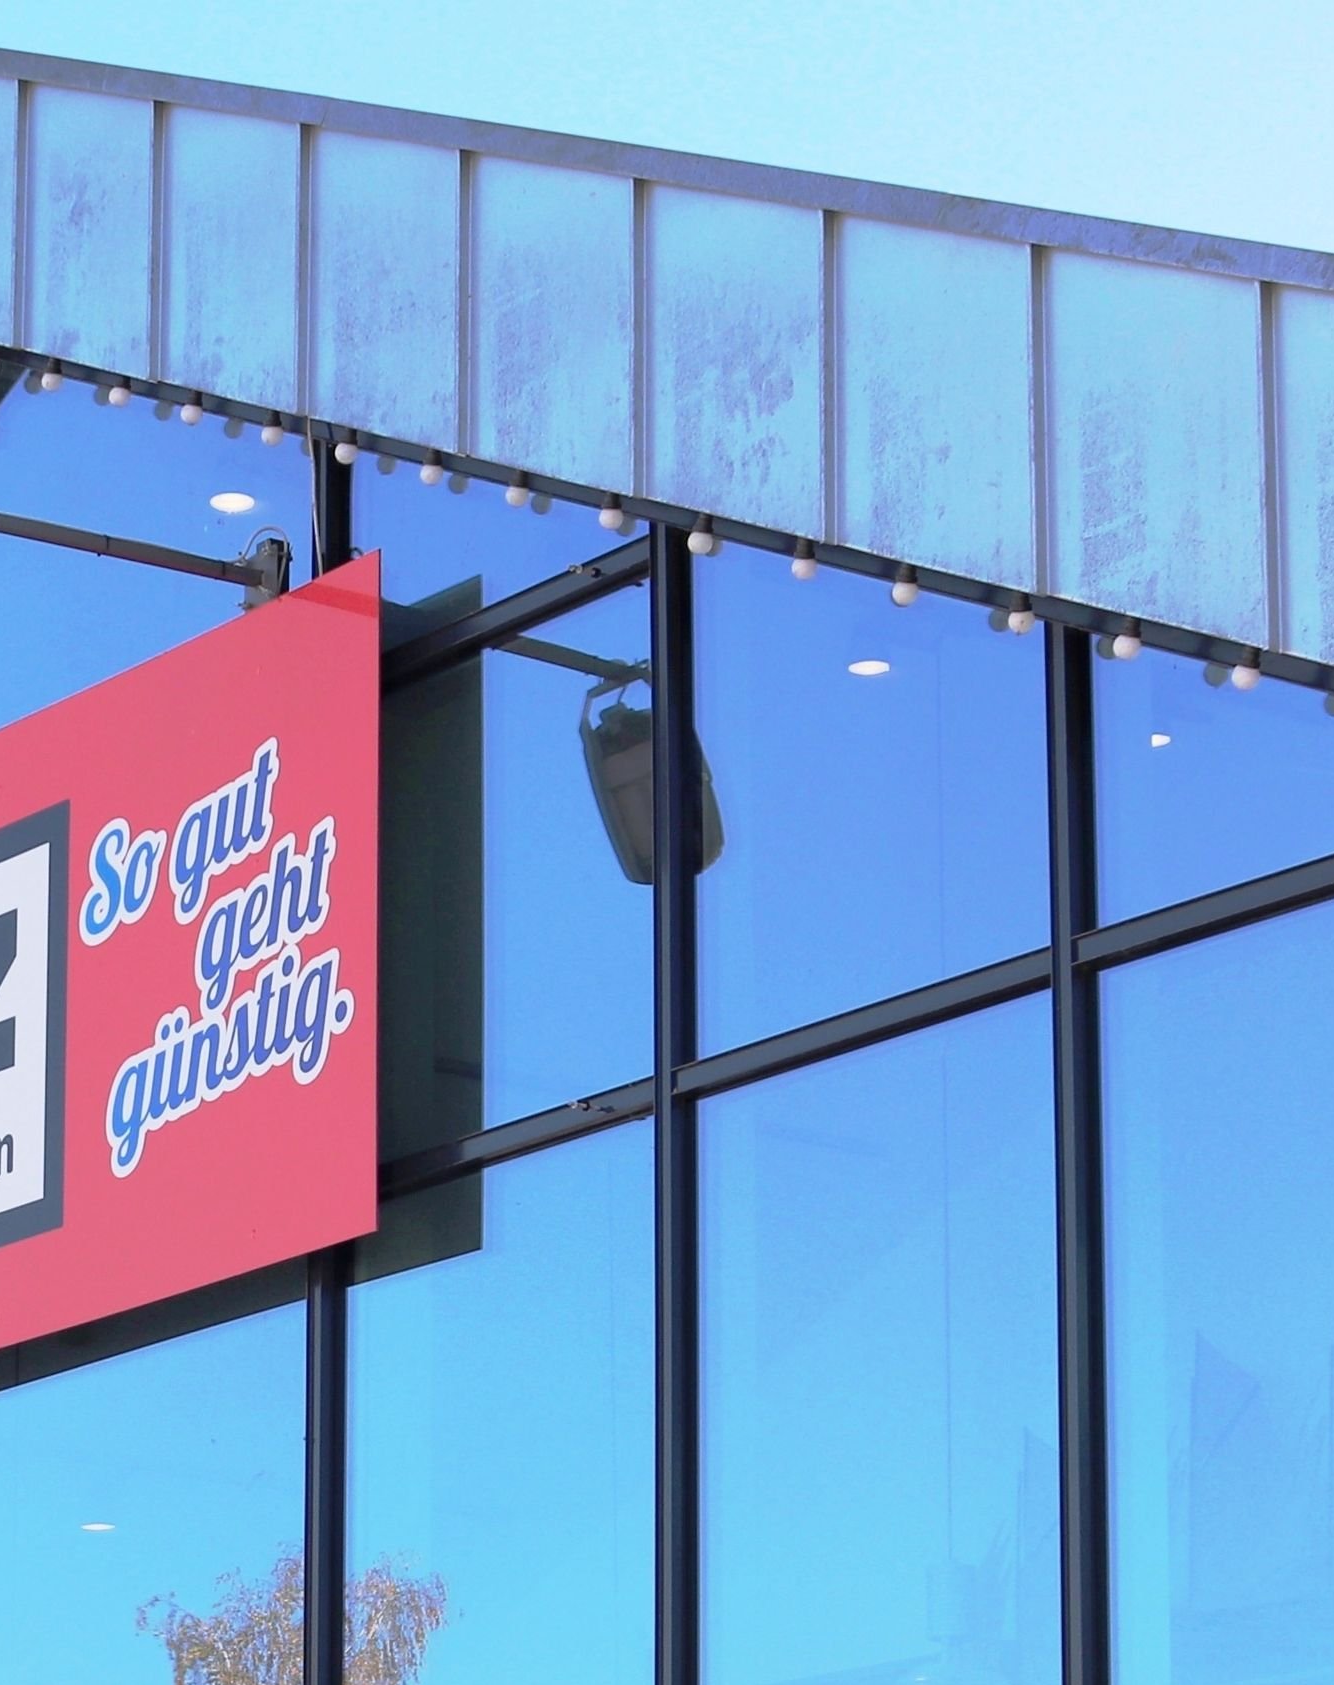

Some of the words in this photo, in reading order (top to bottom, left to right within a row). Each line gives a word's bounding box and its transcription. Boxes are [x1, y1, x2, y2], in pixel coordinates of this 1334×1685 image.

[83, 825, 163, 938] So
[174, 747, 274, 915] gut
[199, 828, 330, 1011] geht
[110, 954, 349, 1168] günstig.
